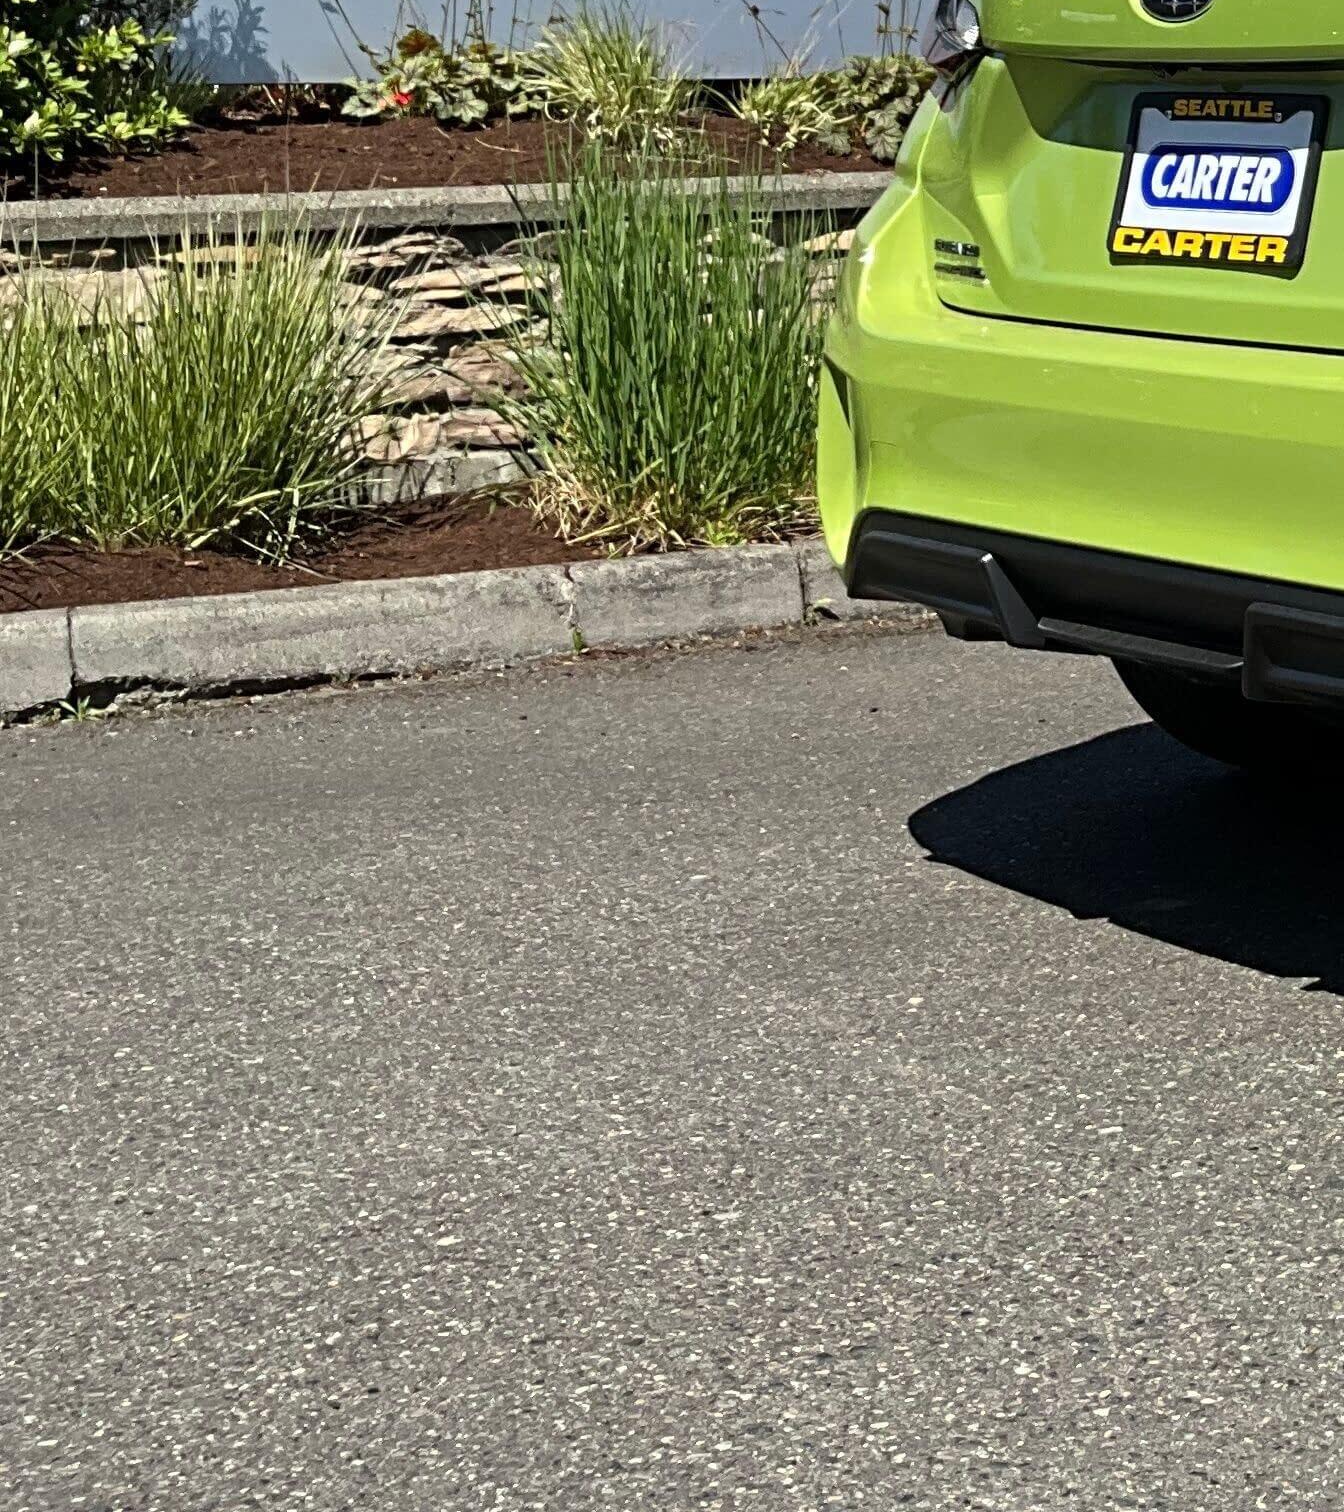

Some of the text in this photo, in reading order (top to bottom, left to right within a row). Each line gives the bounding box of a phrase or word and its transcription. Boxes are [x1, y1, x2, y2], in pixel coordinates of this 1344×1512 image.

[1173, 99, 1274, 118] SEATTLE
[1151, 153, 1282, 203] CARTER
[1112, 227, 1289, 264] CARTER
